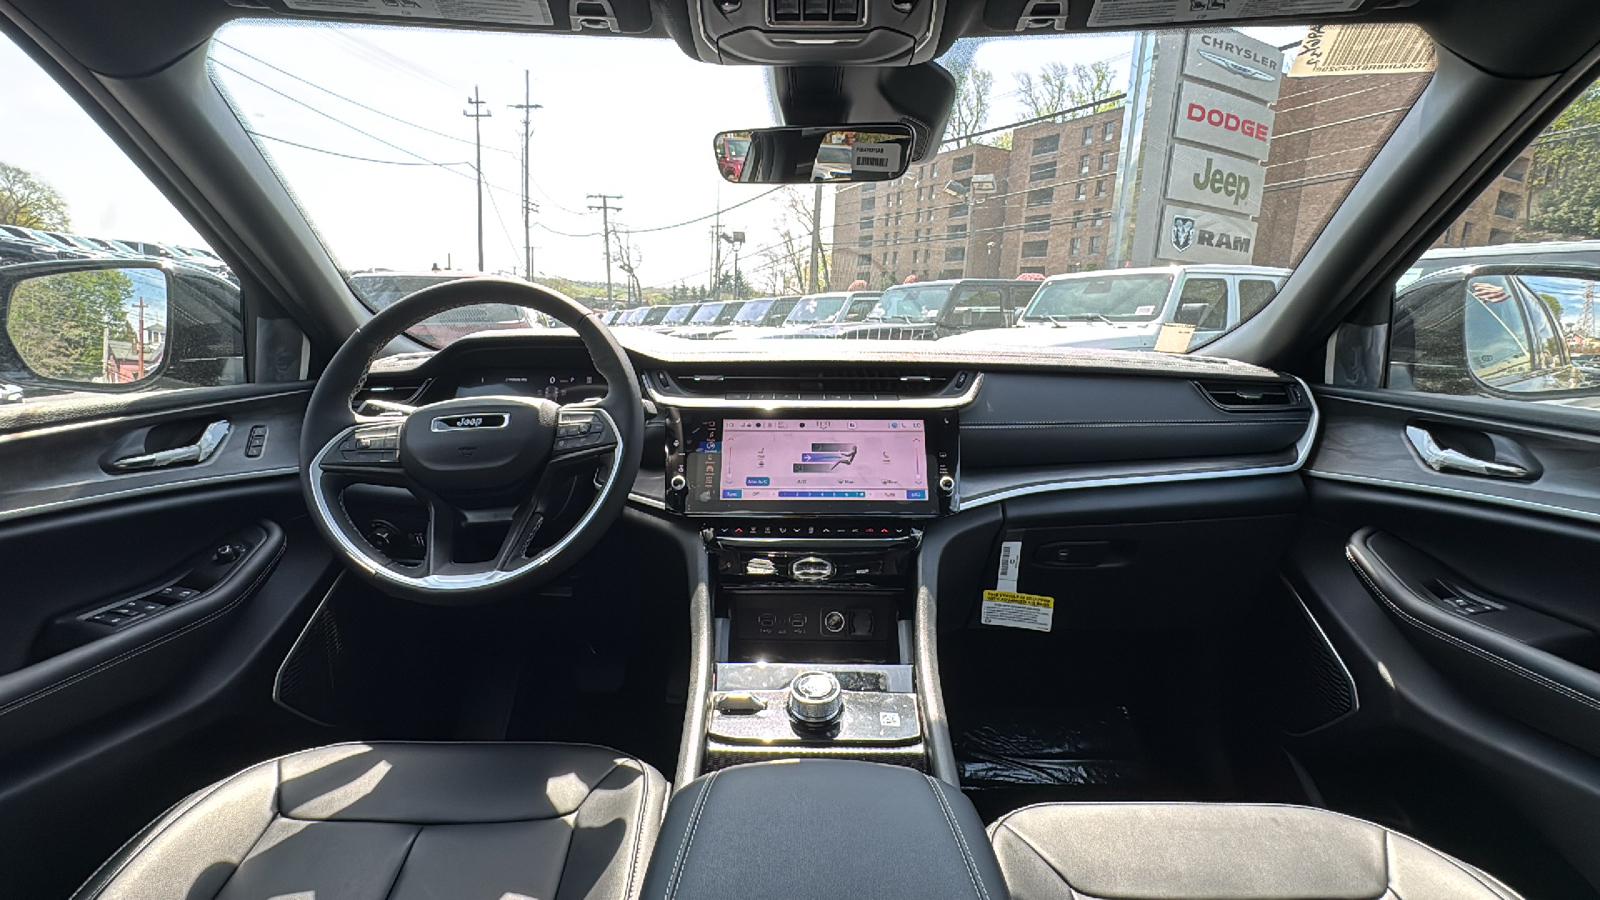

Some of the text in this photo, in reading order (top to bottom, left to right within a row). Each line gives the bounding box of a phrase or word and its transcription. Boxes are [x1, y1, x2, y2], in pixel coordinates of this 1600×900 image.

[1201, 34, 1278, 72] CHRYSLER
[1186, 103, 1269, 142] DODGE
[1193, 157, 1250, 205] Jeep
[1197, 229, 1251, 253] RAM
[549, 376, 556, 386] 0
[457, 417, 483, 427] Jeep
